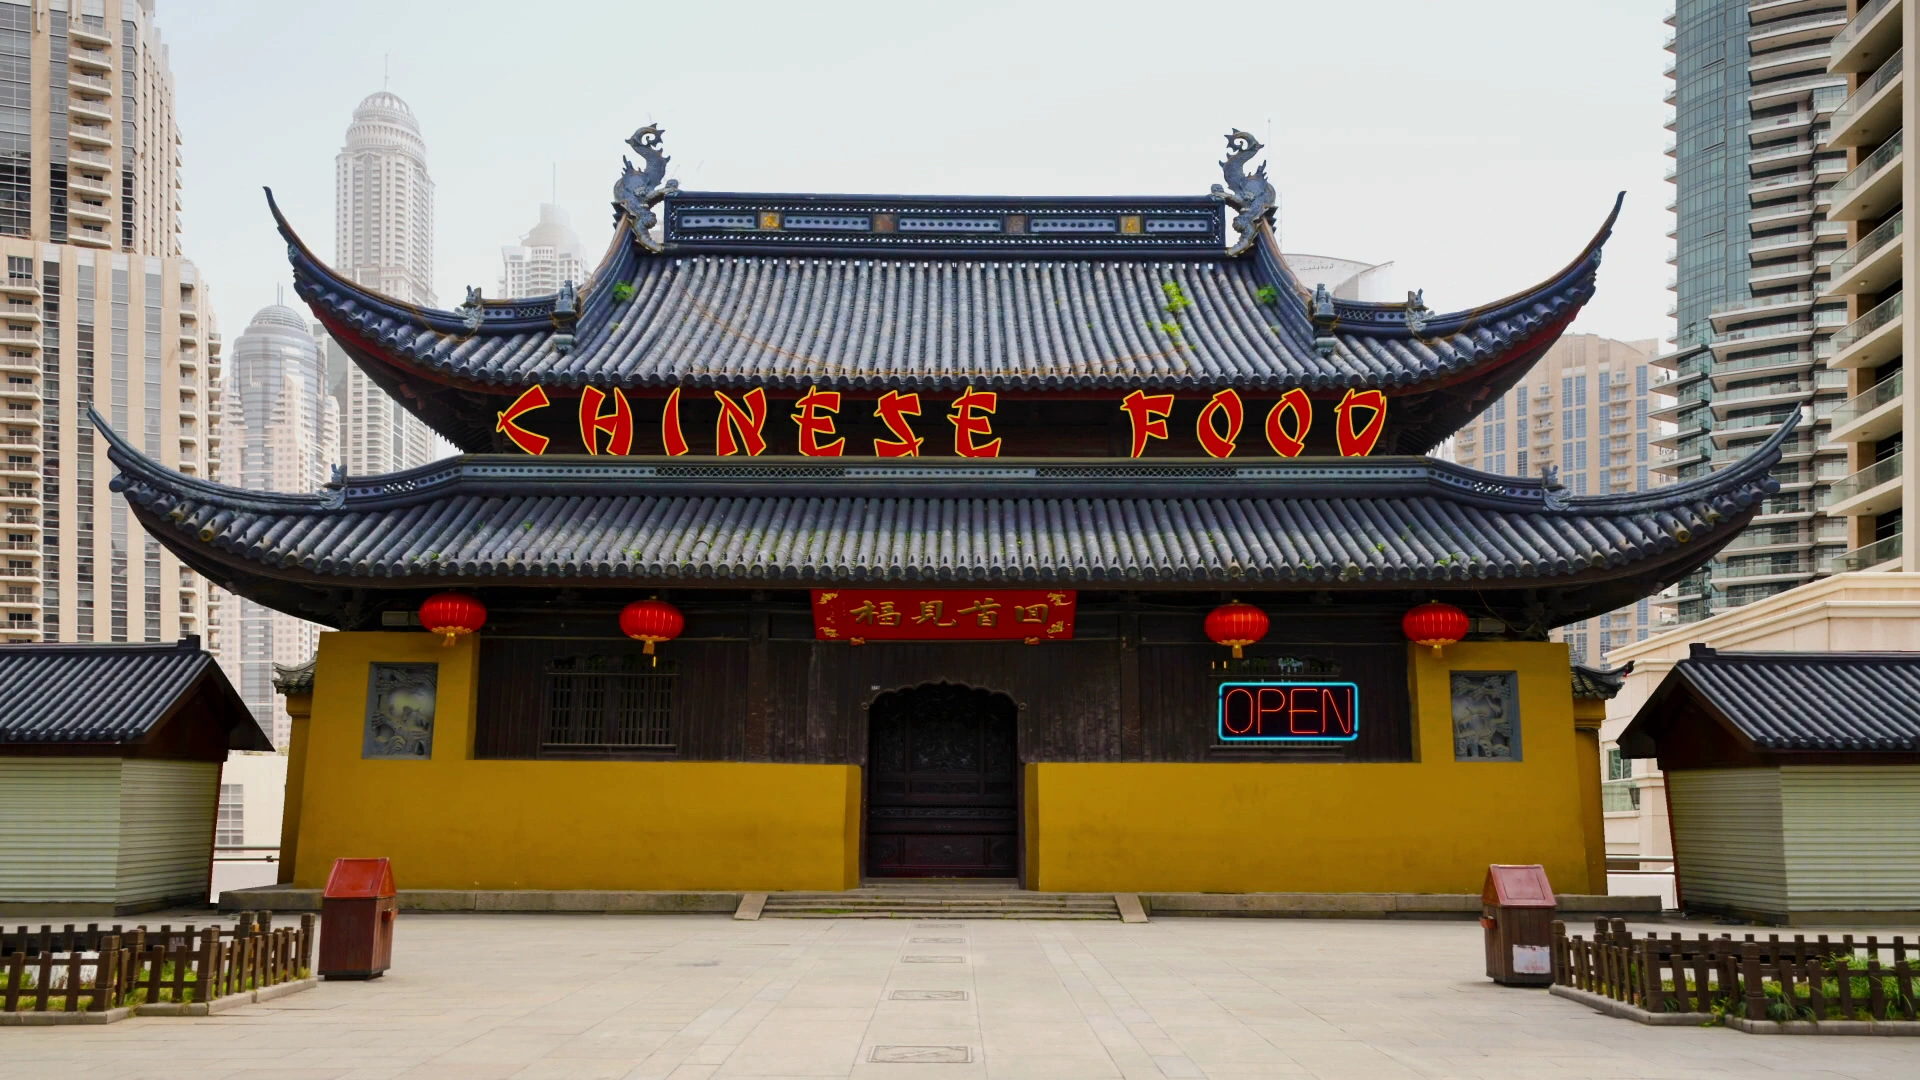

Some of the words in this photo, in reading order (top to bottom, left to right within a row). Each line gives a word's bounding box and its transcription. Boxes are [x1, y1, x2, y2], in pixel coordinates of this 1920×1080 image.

[496, 384, 1002, 458] CHINESE
[1119, 387, 1388, 458] FOOD
[1224, 688, 1351, 735] OPEN
